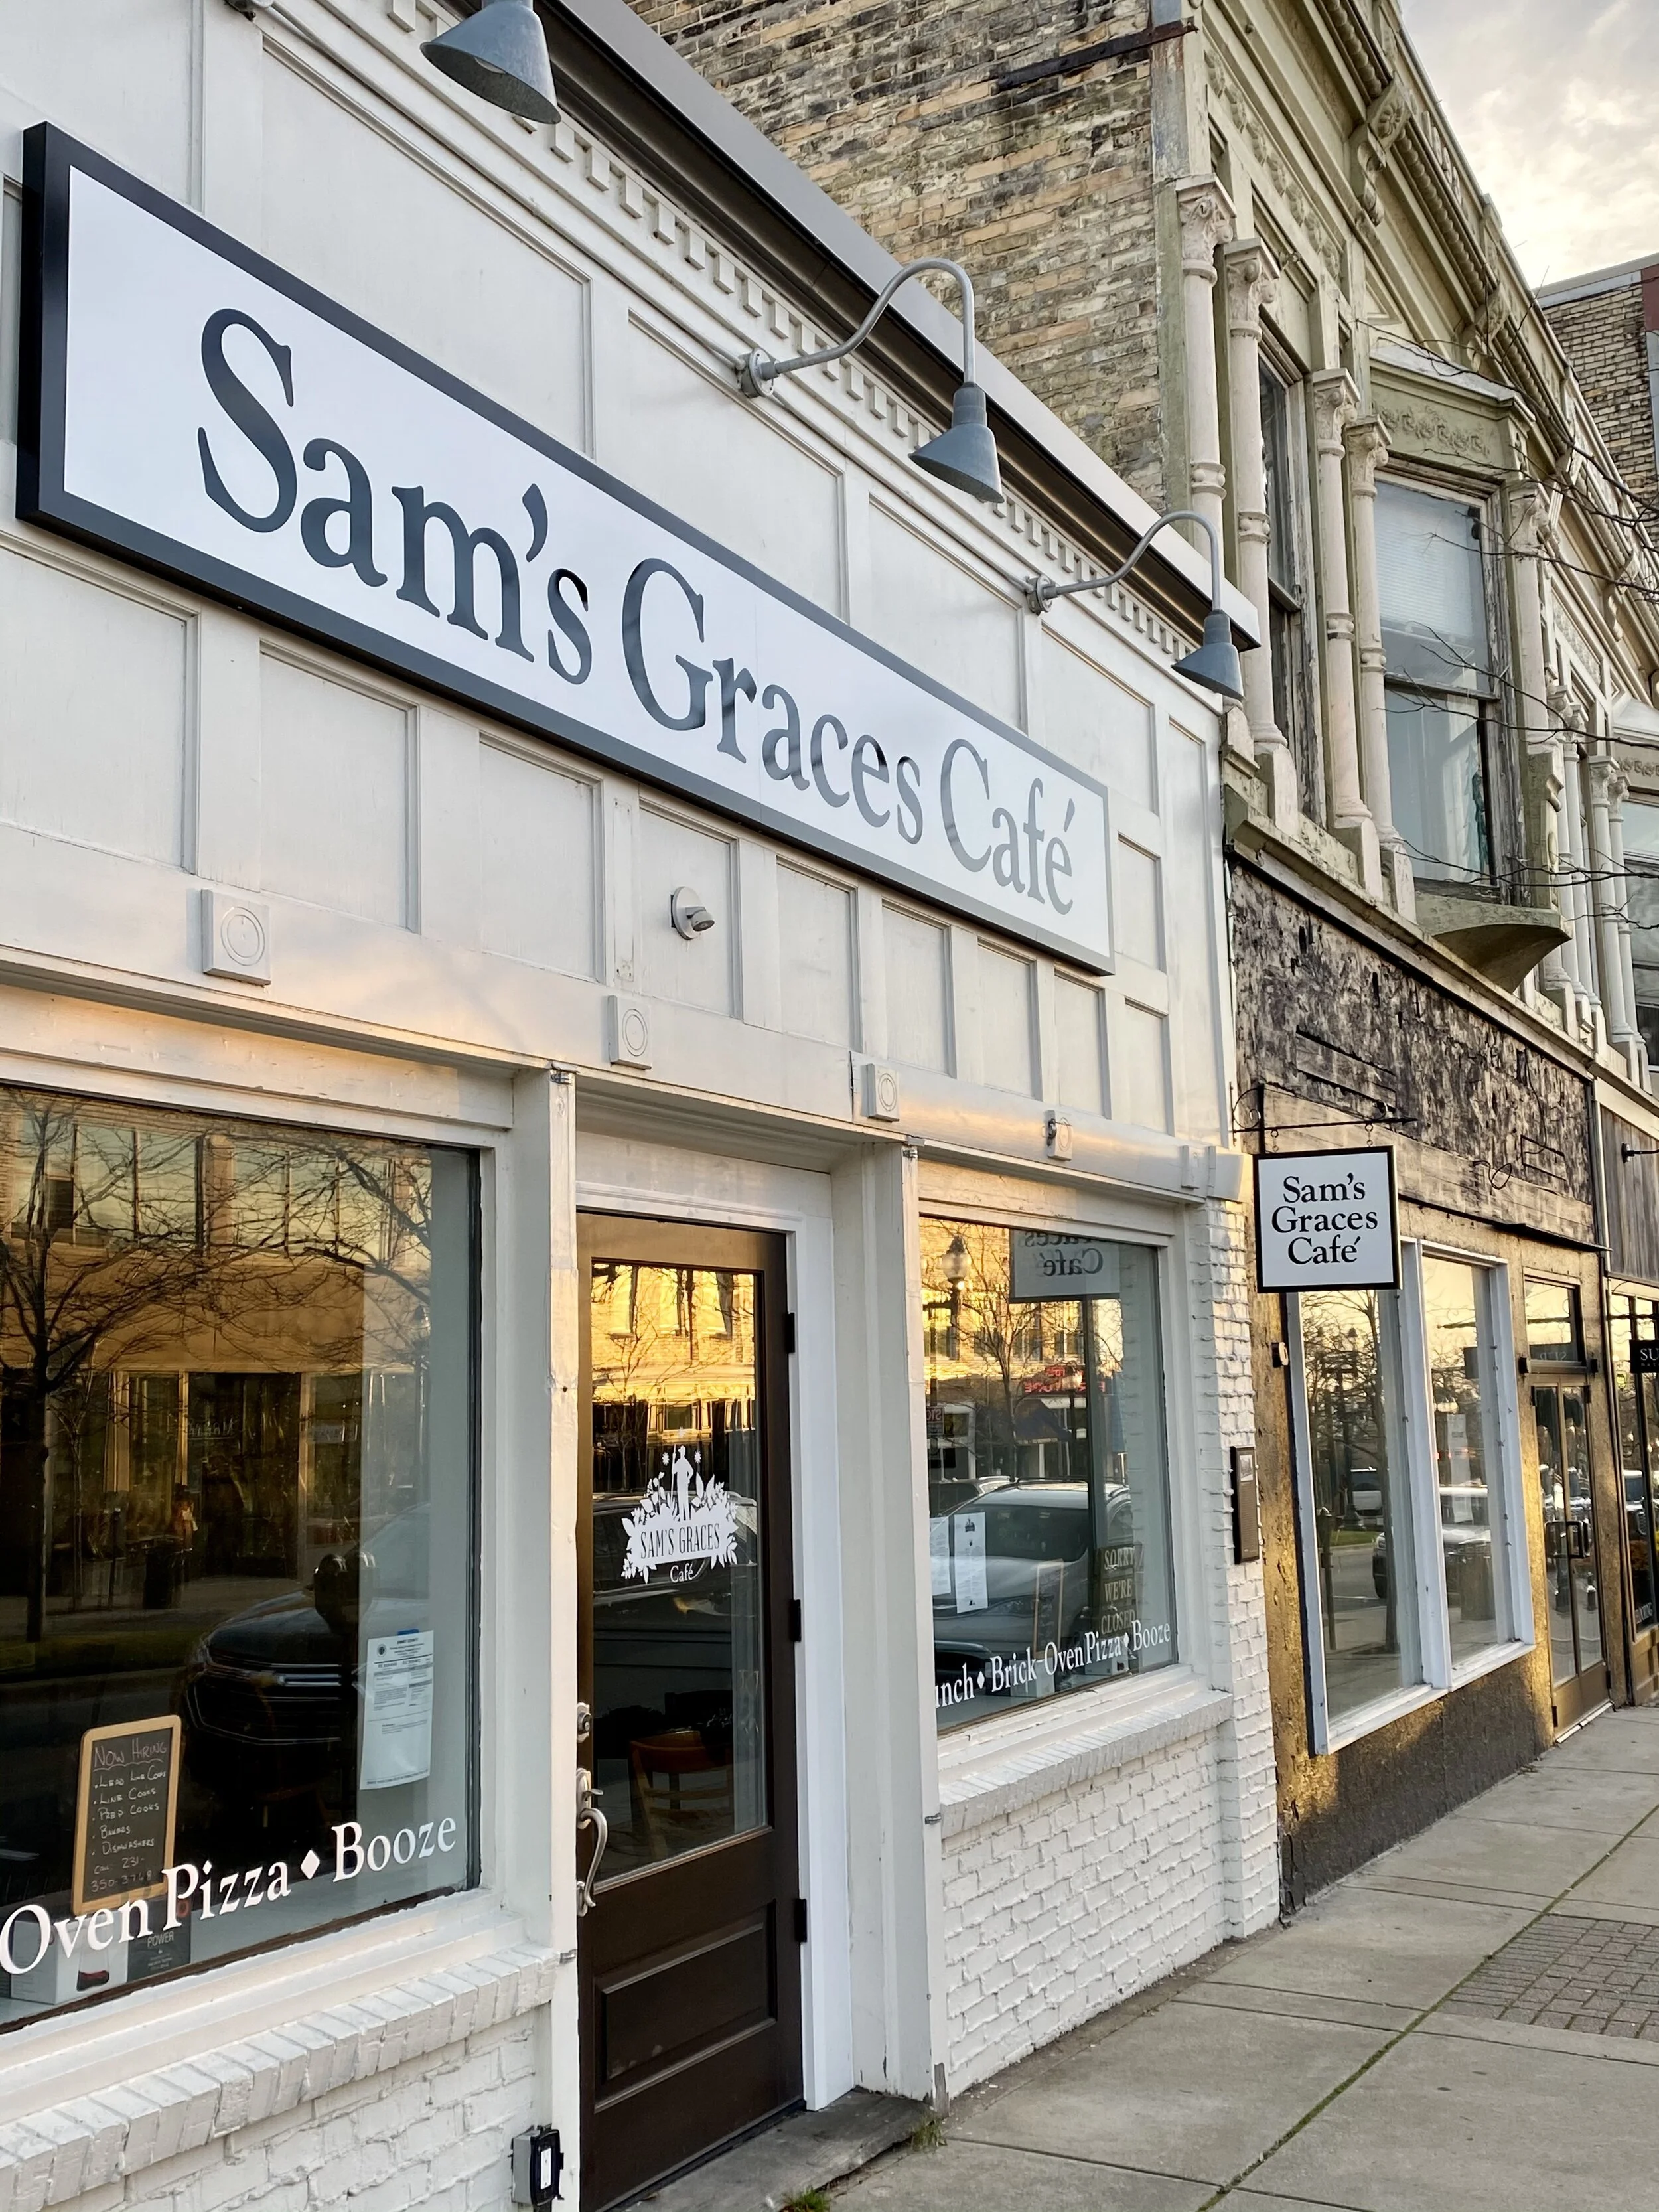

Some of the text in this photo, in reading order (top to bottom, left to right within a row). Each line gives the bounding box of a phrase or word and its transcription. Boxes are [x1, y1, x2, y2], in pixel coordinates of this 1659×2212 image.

[198, 308, 1074, 915] Sam's Graces Café
[1283, 1173, 1366, 1203] Sam's
[1271, 1206, 1378, 1233] Graces
[1288, 1234, 1361, 1264] Café
[640, 1523, 720, 1559] SAM'S GRACES
[670, 1562, 694, 1583] Café
[1104, 1547, 1135, 1570] SORRY
[1104, 1578, 1133, 1602] WE'RE
[1101, 1609, 1135, 1635] CLOSED
[1084, 1631, 1121, 1664] Pizza
[1131, 1619, 1171, 1651] Booze
[94, 1737, 167, 1767] NOW HIRING
[0, 1899, 153, 1975] Oven
[161, 1860, 292, 1931] Pizza
[331, 1817, 457, 1883] Booze
